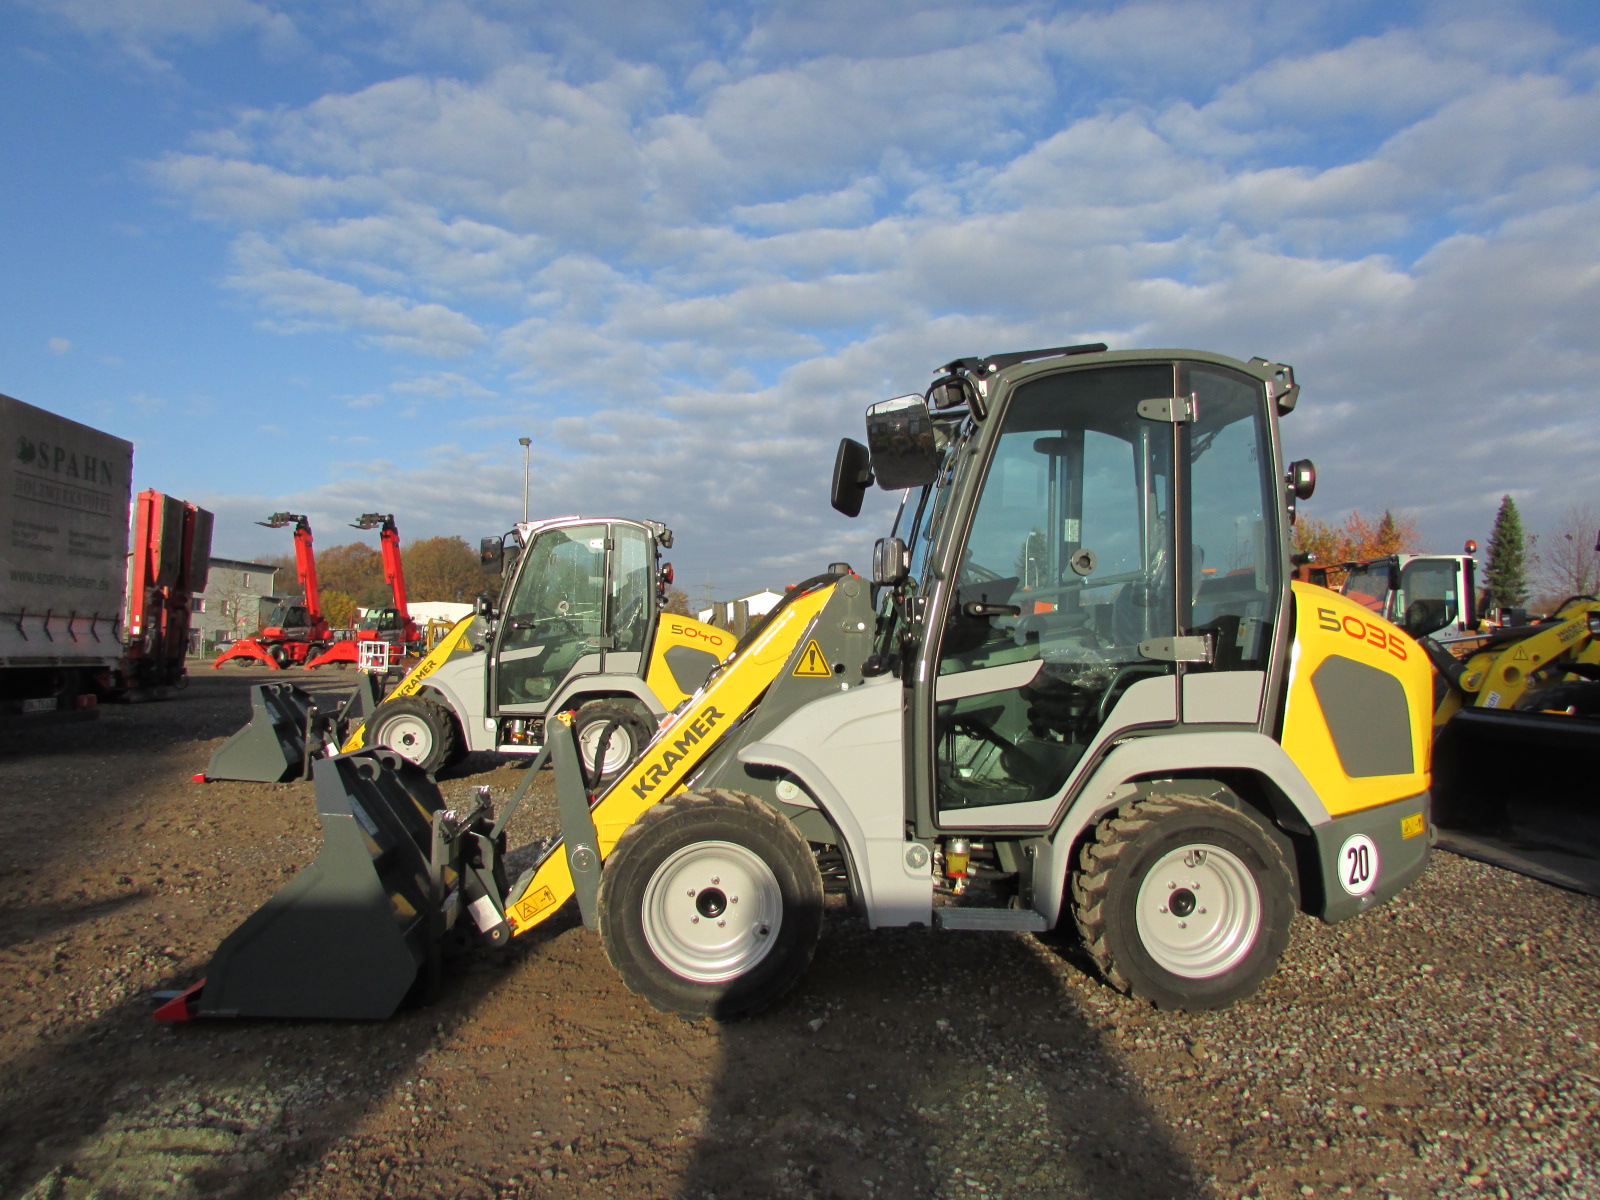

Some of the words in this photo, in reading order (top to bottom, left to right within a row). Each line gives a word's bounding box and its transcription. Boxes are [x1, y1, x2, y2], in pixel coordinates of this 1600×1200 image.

[38, 442, 114, 486] SPAHN
[671, 624, 723, 646] 5040
[1317, 607, 1408, 662] 5035
[397, 660, 437, 698] KRAMER
[631, 705, 725, 800] KRAMER
[1347, 844, 1369, 885] 20
